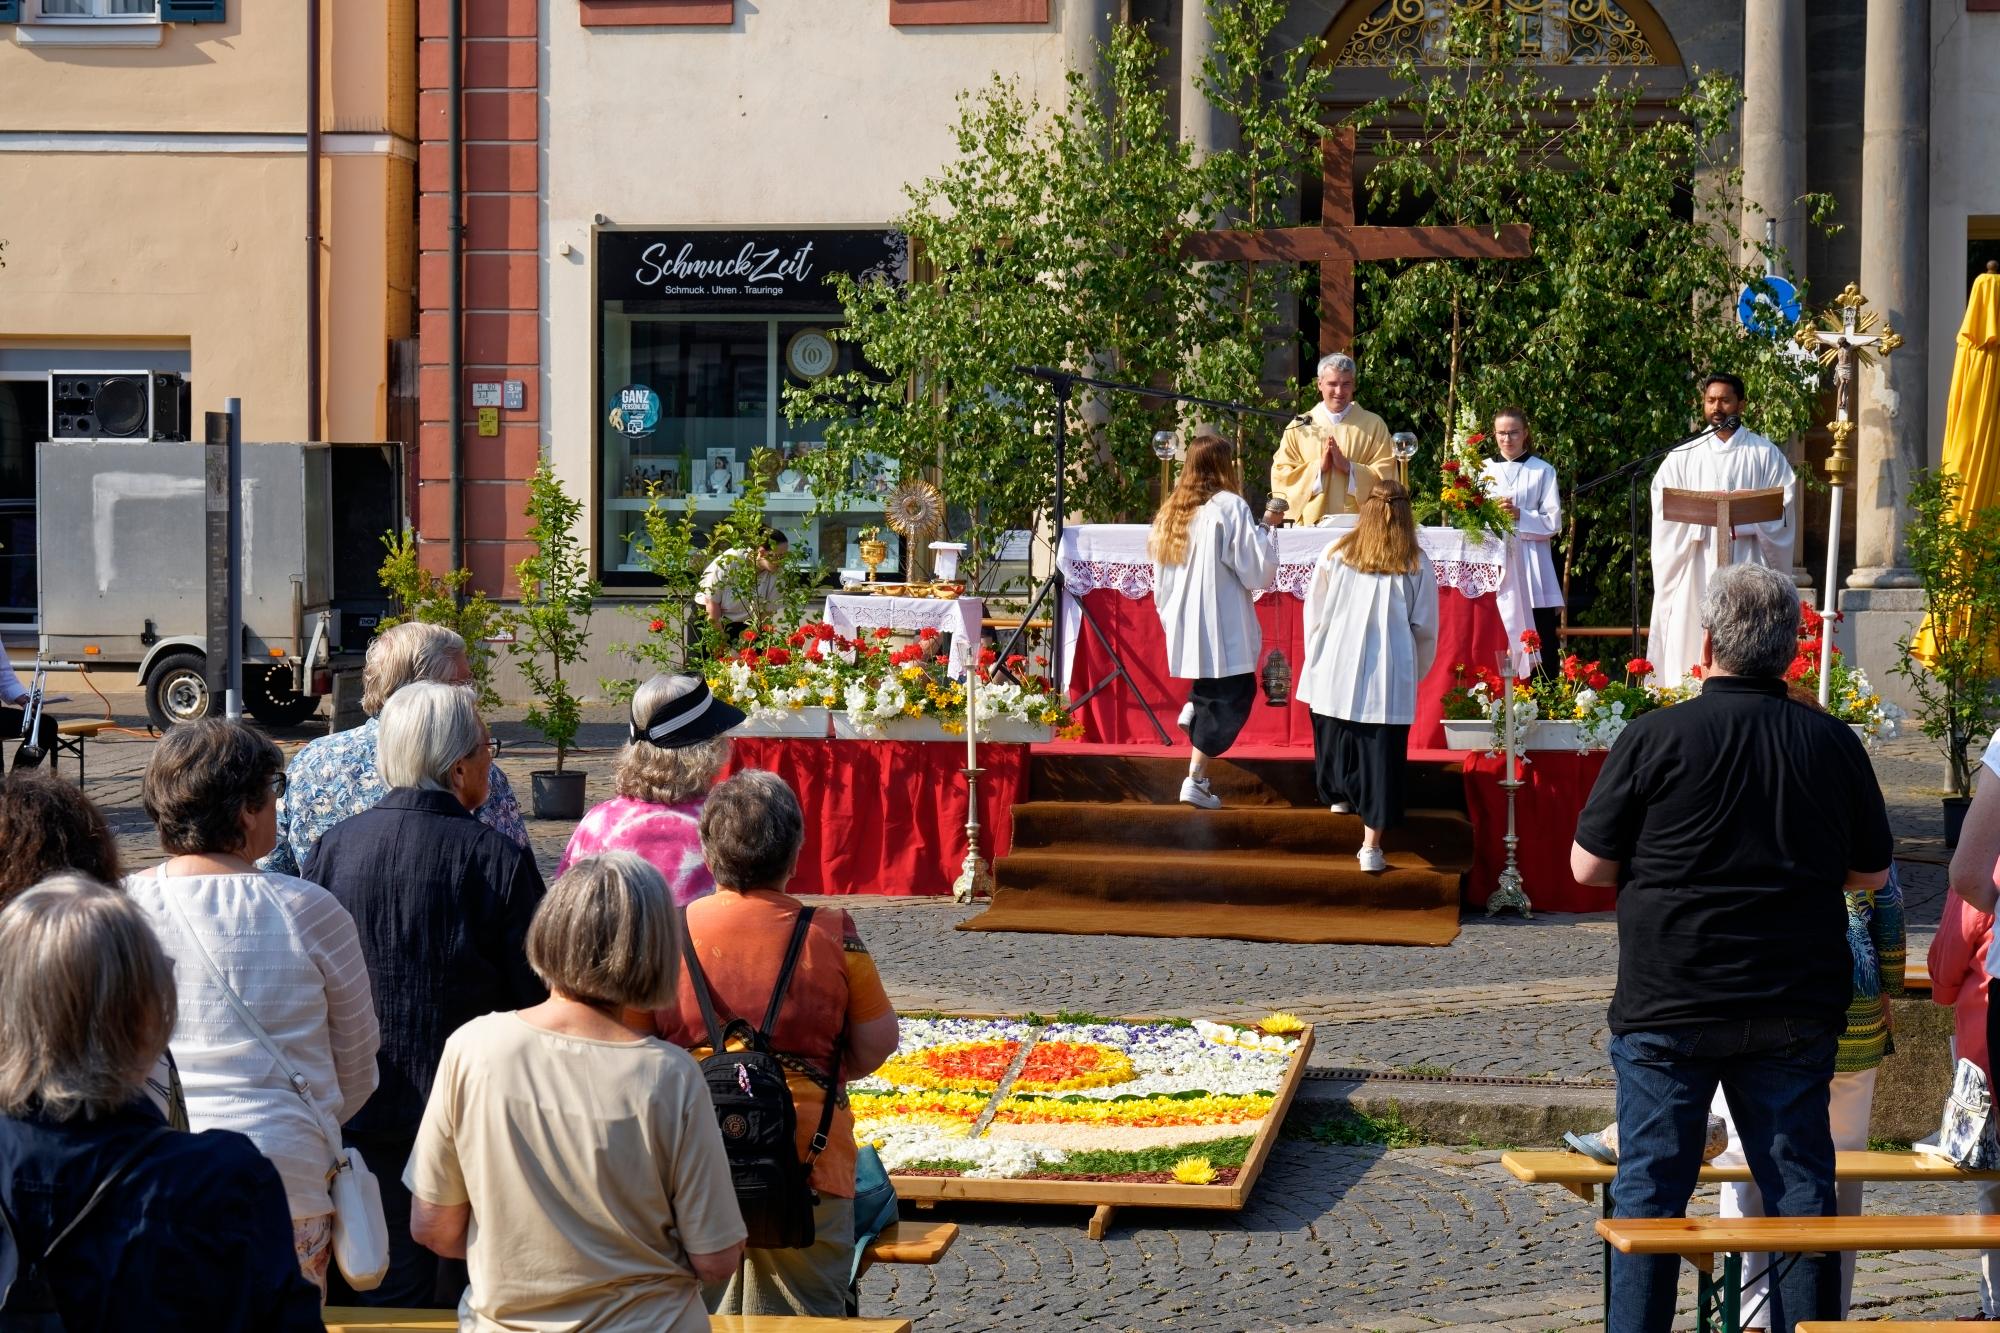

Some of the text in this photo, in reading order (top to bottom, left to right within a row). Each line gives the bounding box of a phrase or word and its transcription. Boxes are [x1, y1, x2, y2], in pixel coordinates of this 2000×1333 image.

[635, 241, 814, 286] SchmuckZeit
[665, 285, 705, 295] Schmuck
[711, 285, 737, 295] Uhren
[744, 285, 784, 296] Trauringe
[621, 389, 650, 404] GANZ
